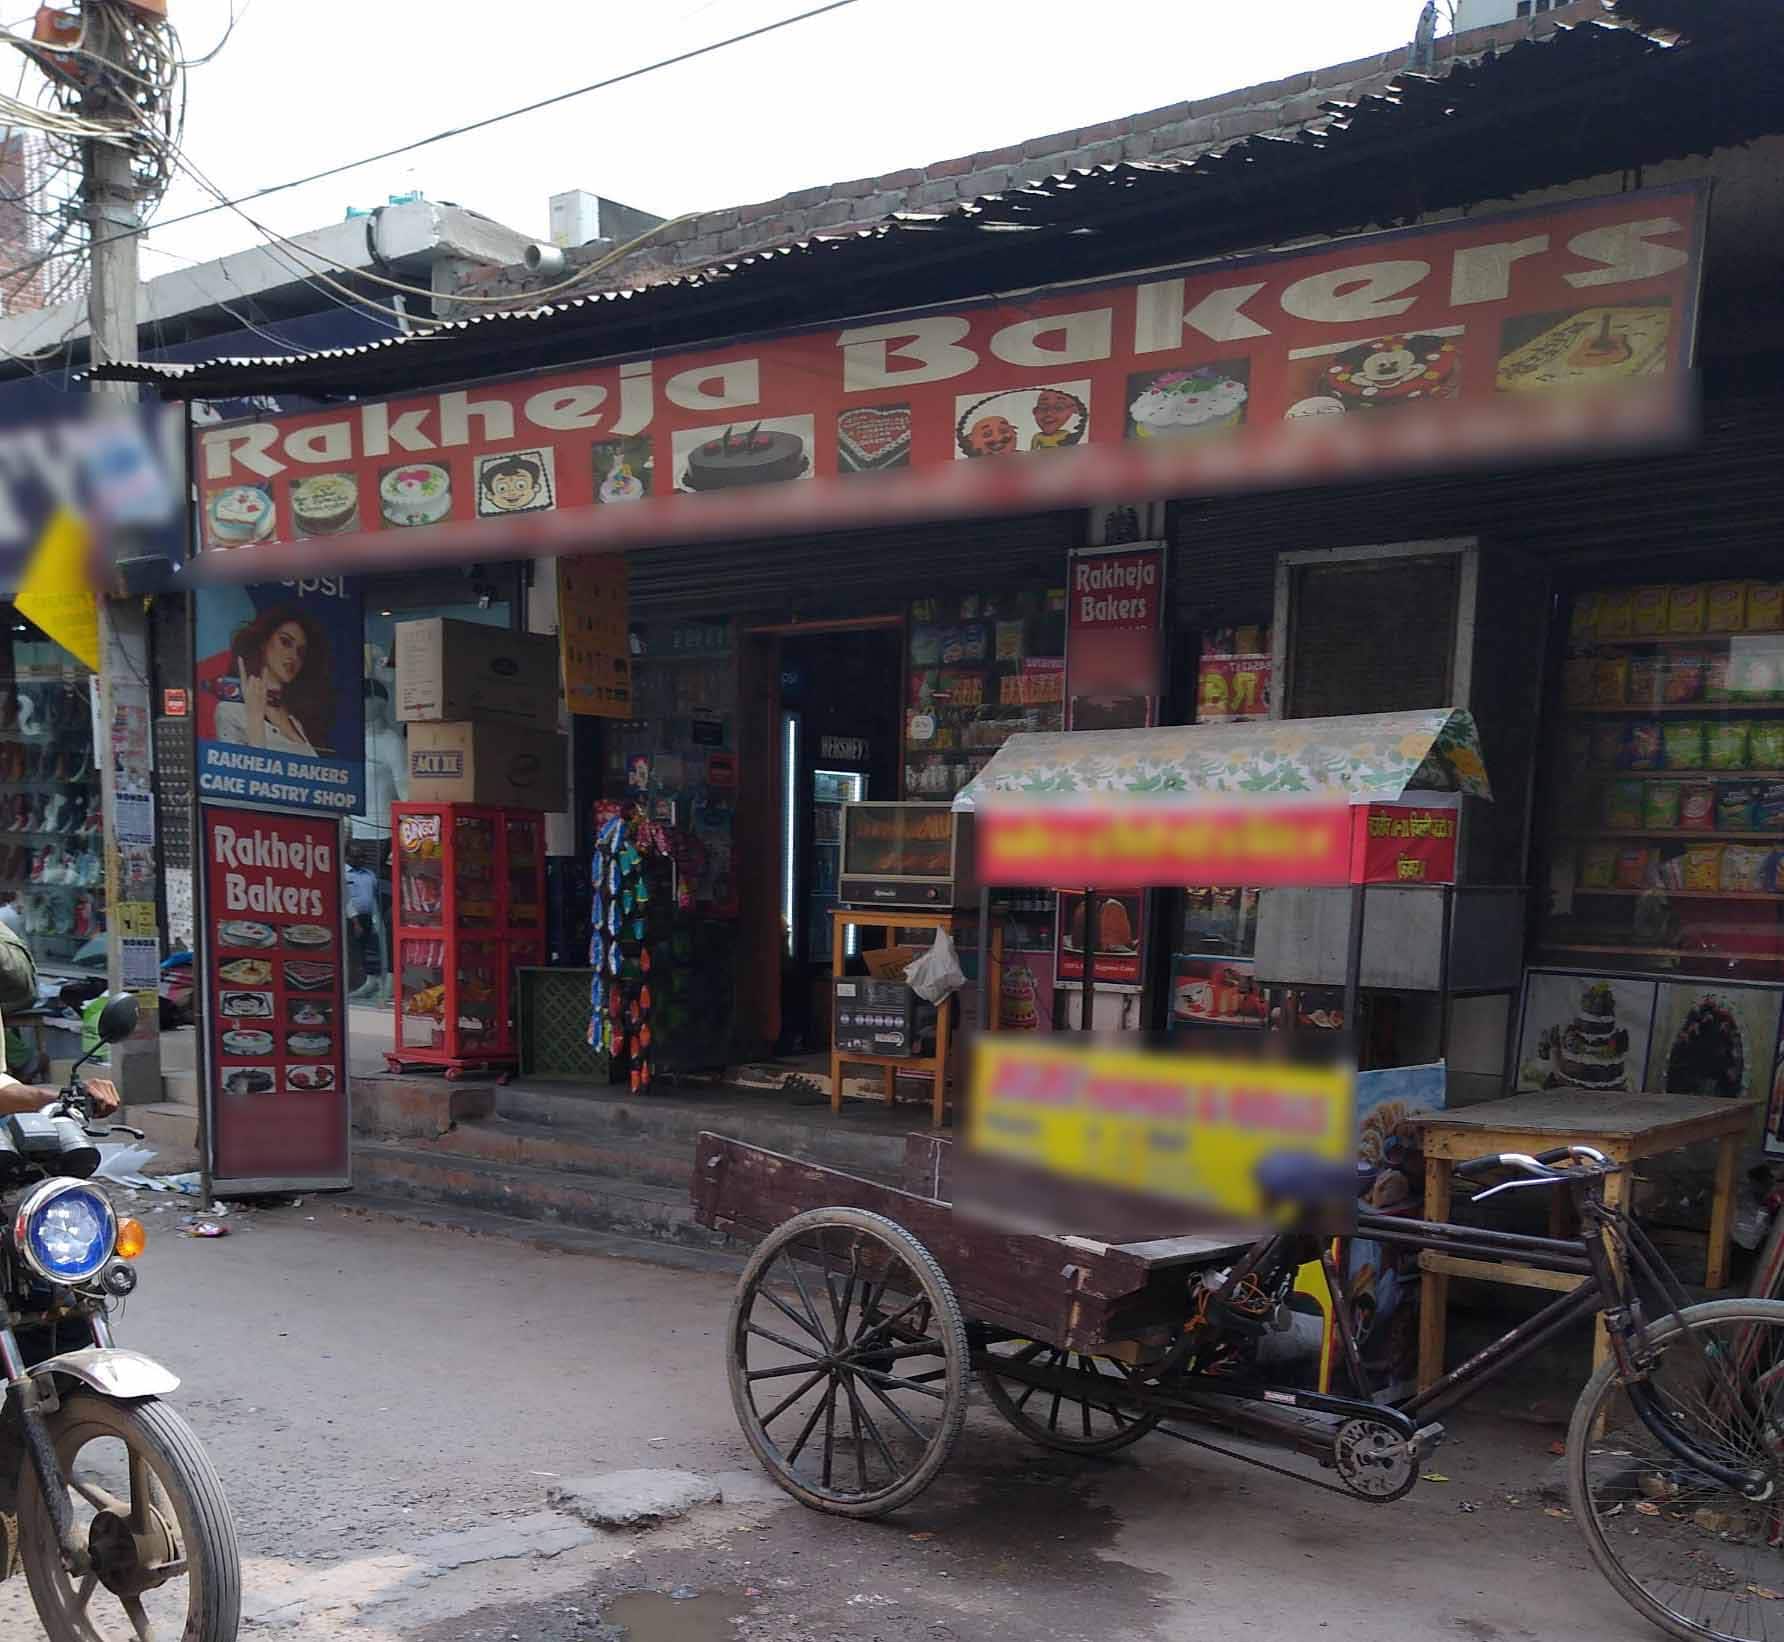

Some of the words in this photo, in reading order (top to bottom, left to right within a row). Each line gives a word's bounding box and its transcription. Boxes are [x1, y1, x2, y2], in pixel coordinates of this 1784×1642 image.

[199, 359, 760, 479] Rakheja
[836, 216, 1691, 394] Bakers
[1076, 560, 1156, 593] Rakheja
[1081, 595, 1147, 622] Bakers
[207, 749, 284, 776] RAKHEJA
[287, 763, 350, 785] BAKERS
[200, 773, 245, 794] CAKE
[249, 781, 310, 803] PASTRY
[312, 789, 357, 809] SHOP
[214, 825, 331, 880] Rakheja
[225, 873, 323, 917] Bakers
